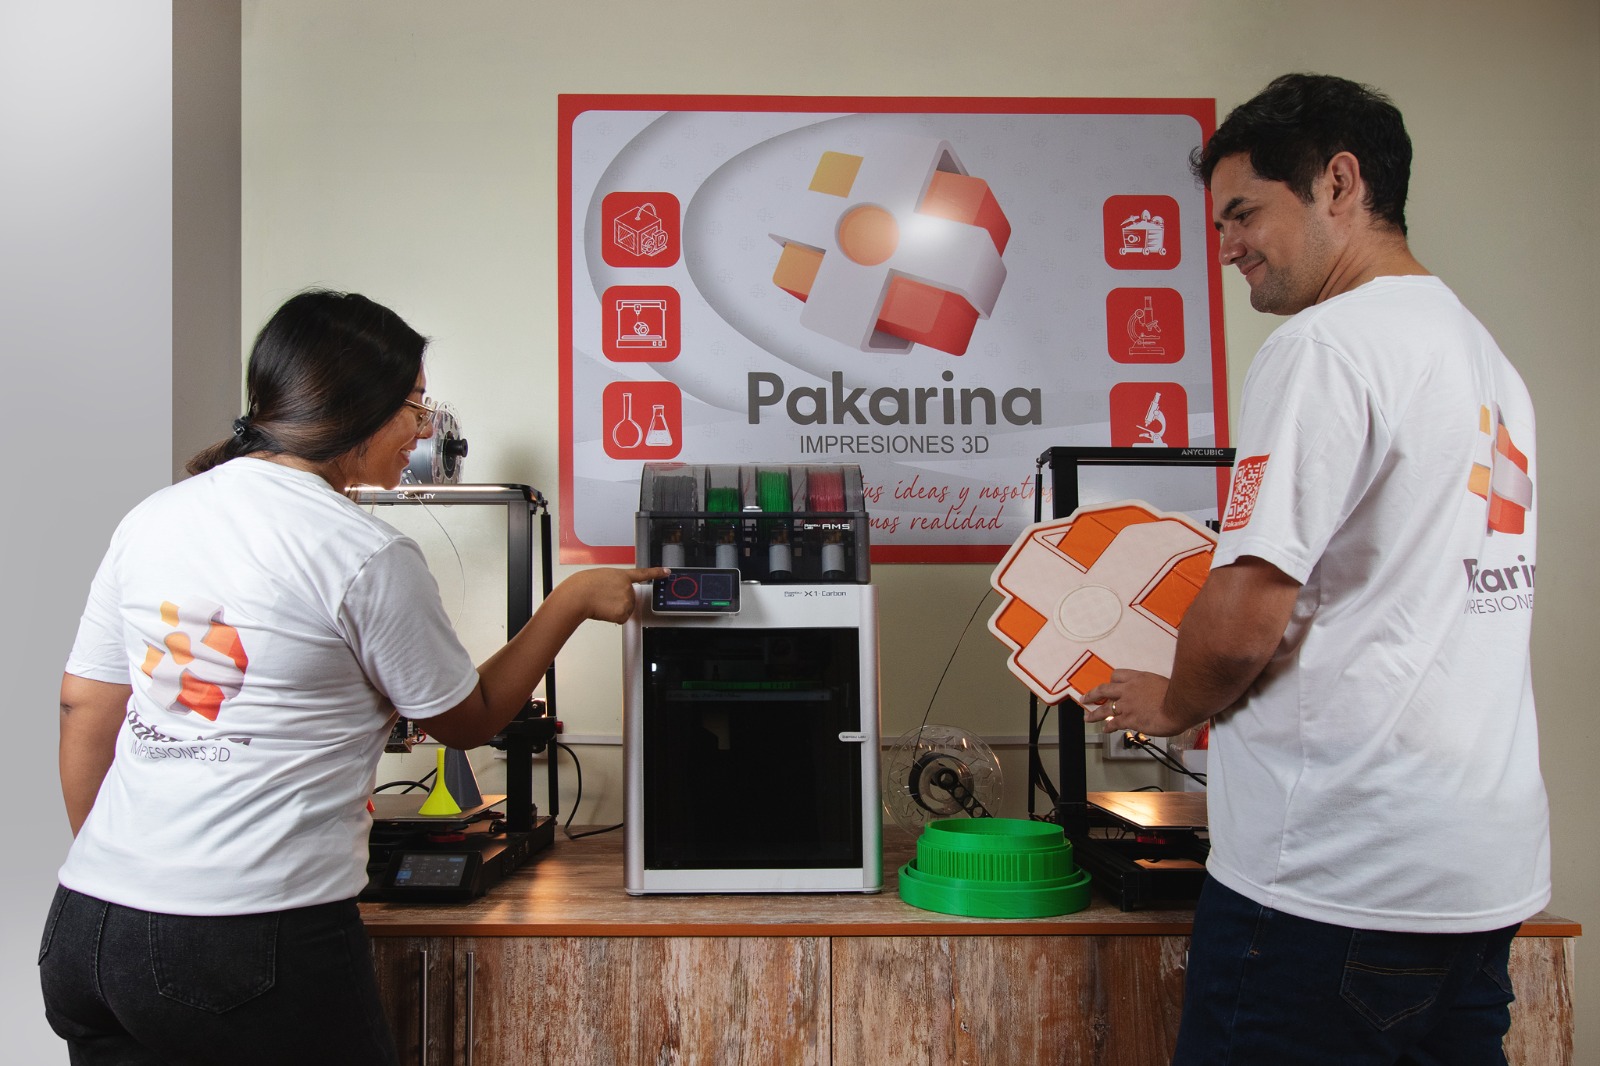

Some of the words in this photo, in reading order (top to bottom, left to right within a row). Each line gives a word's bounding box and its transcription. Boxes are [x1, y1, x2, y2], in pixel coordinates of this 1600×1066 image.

[748, 370, 1042, 426] Pakarina
[800, 435, 955, 454] IMPRESIONES
[962, 435, 989, 454] 3D
[895, 474, 950, 503] ideas
[958, 484, 970, 511] y
[910, 505, 1004, 531] realidad
[209, 746, 231, 763] 3D
